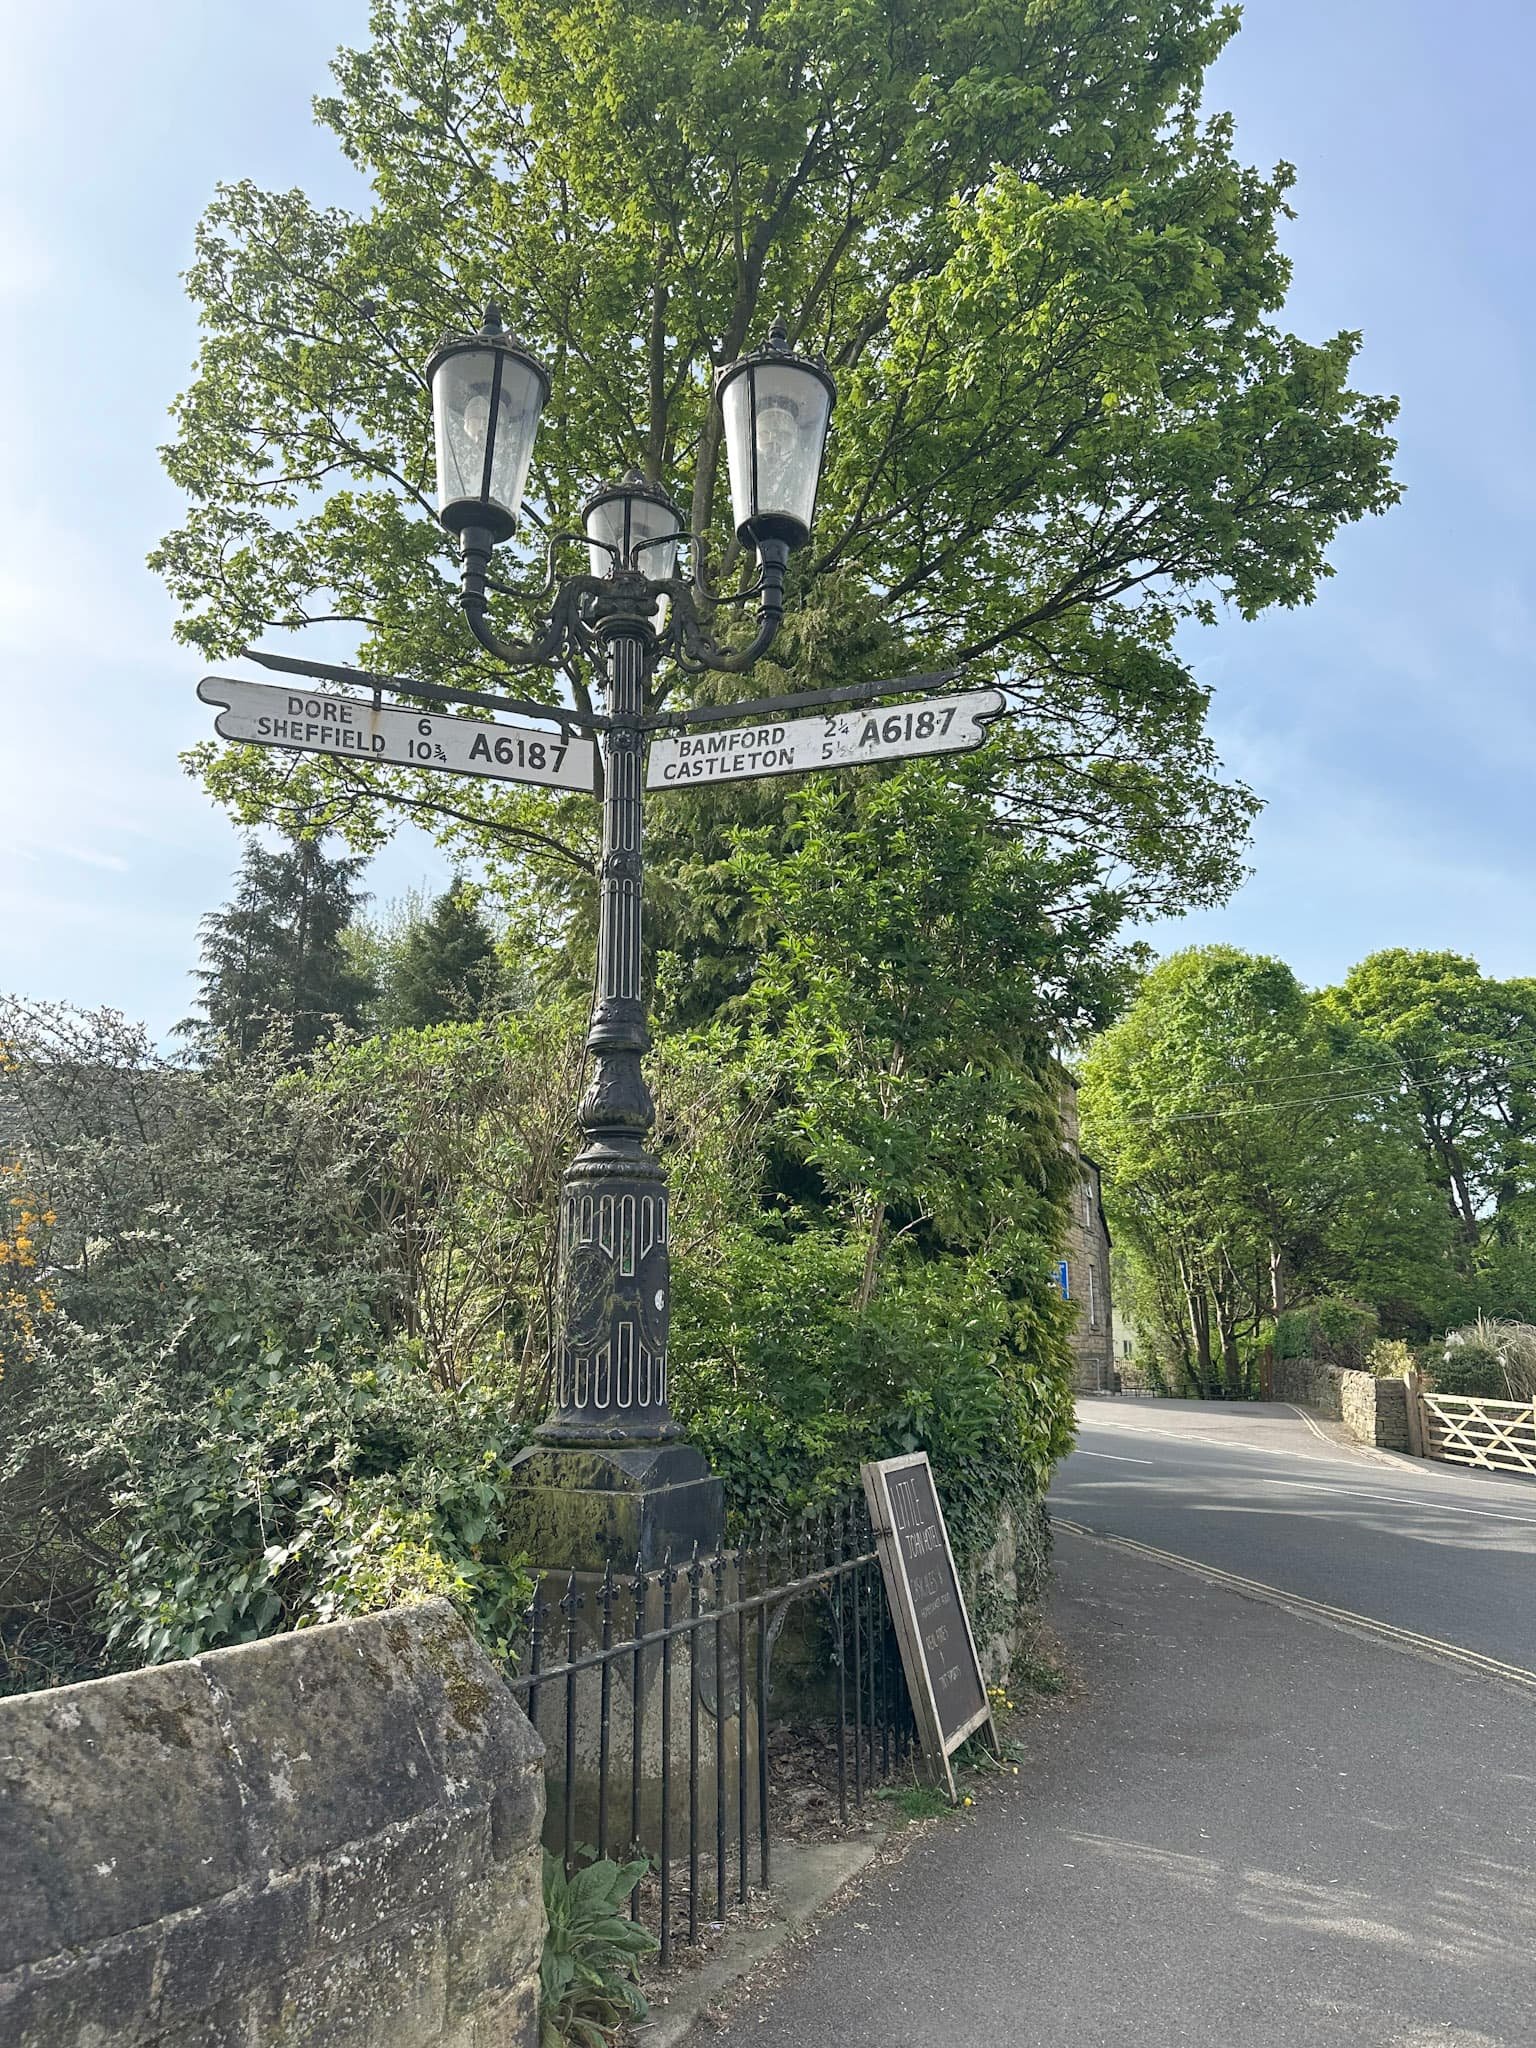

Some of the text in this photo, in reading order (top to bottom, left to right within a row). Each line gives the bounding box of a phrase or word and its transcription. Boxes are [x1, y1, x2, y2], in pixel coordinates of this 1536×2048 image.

[256, 717, 386, 753] SHEFFIELD
[287, 695, 432, 737] DORE 6
[858, 706, 958, 748] A6187
[468, 732, 569, 773] A6187
[679, 727, 785, 758] BAMFORD
[663, 747, 795, 780] CASTLETON
[889, 1478, 925, 1531] LITTLE
